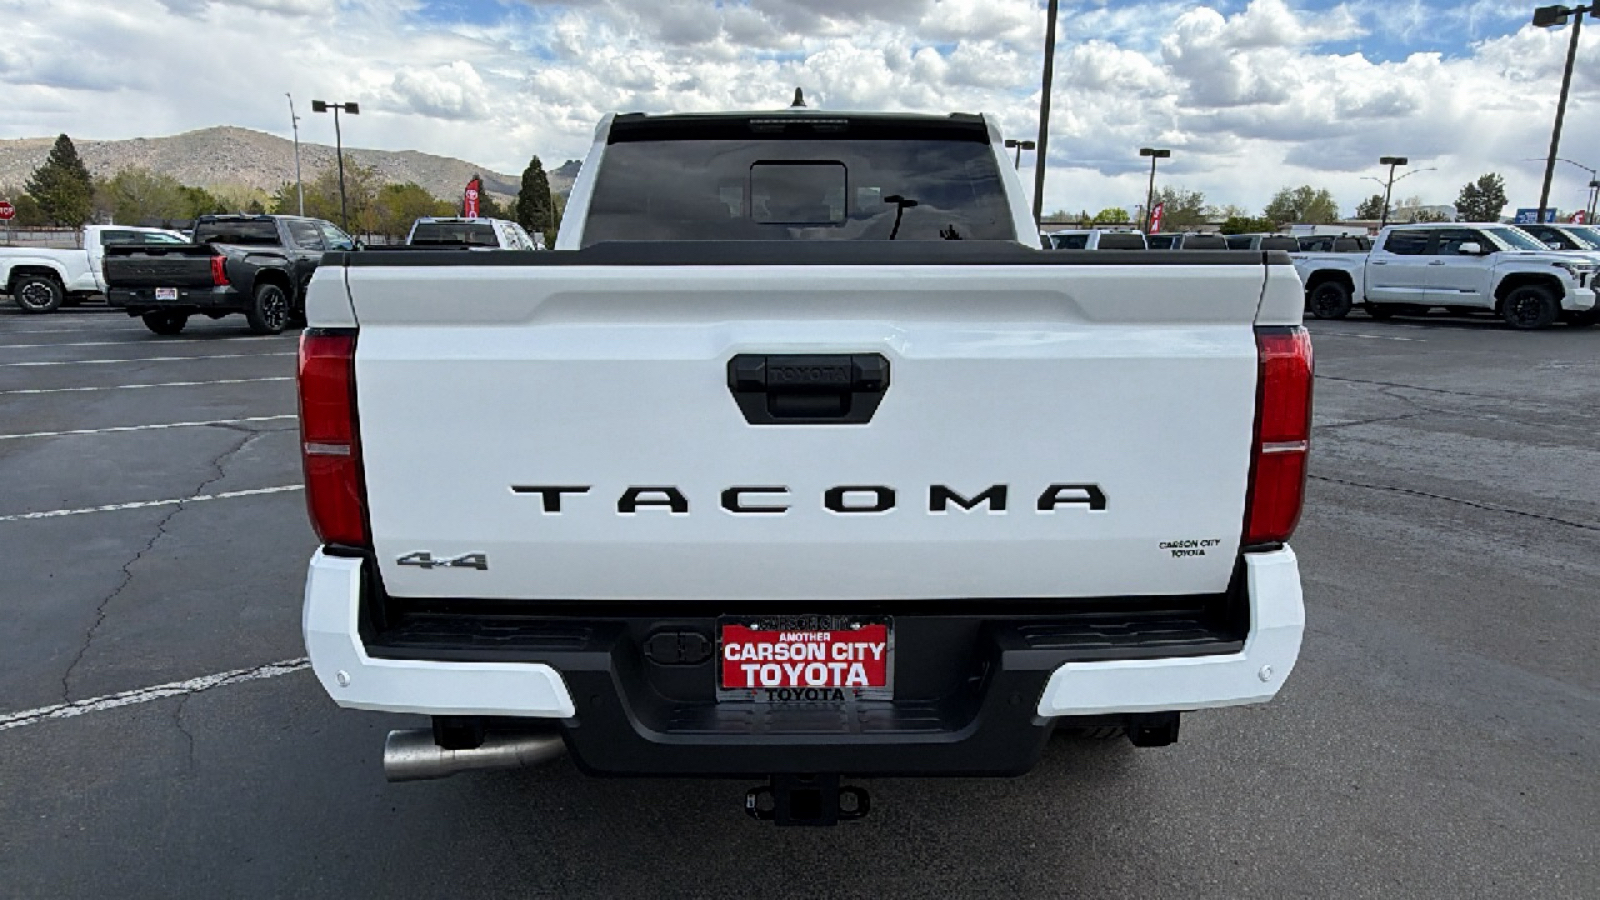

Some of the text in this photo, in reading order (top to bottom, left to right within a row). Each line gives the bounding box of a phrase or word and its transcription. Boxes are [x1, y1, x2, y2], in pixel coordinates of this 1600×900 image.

[769, 366, 847, 382] TOYOTA
[510, 484, 1108, 514] TACOMA
[1159, 539, 1221, 549] CARSON CITY
[1171, 549, 1206, 558] TOYOTA
[779, 632, 831, 642] ANOTHER
[724, 642, 886, 661] CARSON CITY
[740, 662, 870, 686] TOYOTA
[766, 689, 846, 701] TOYOTA
